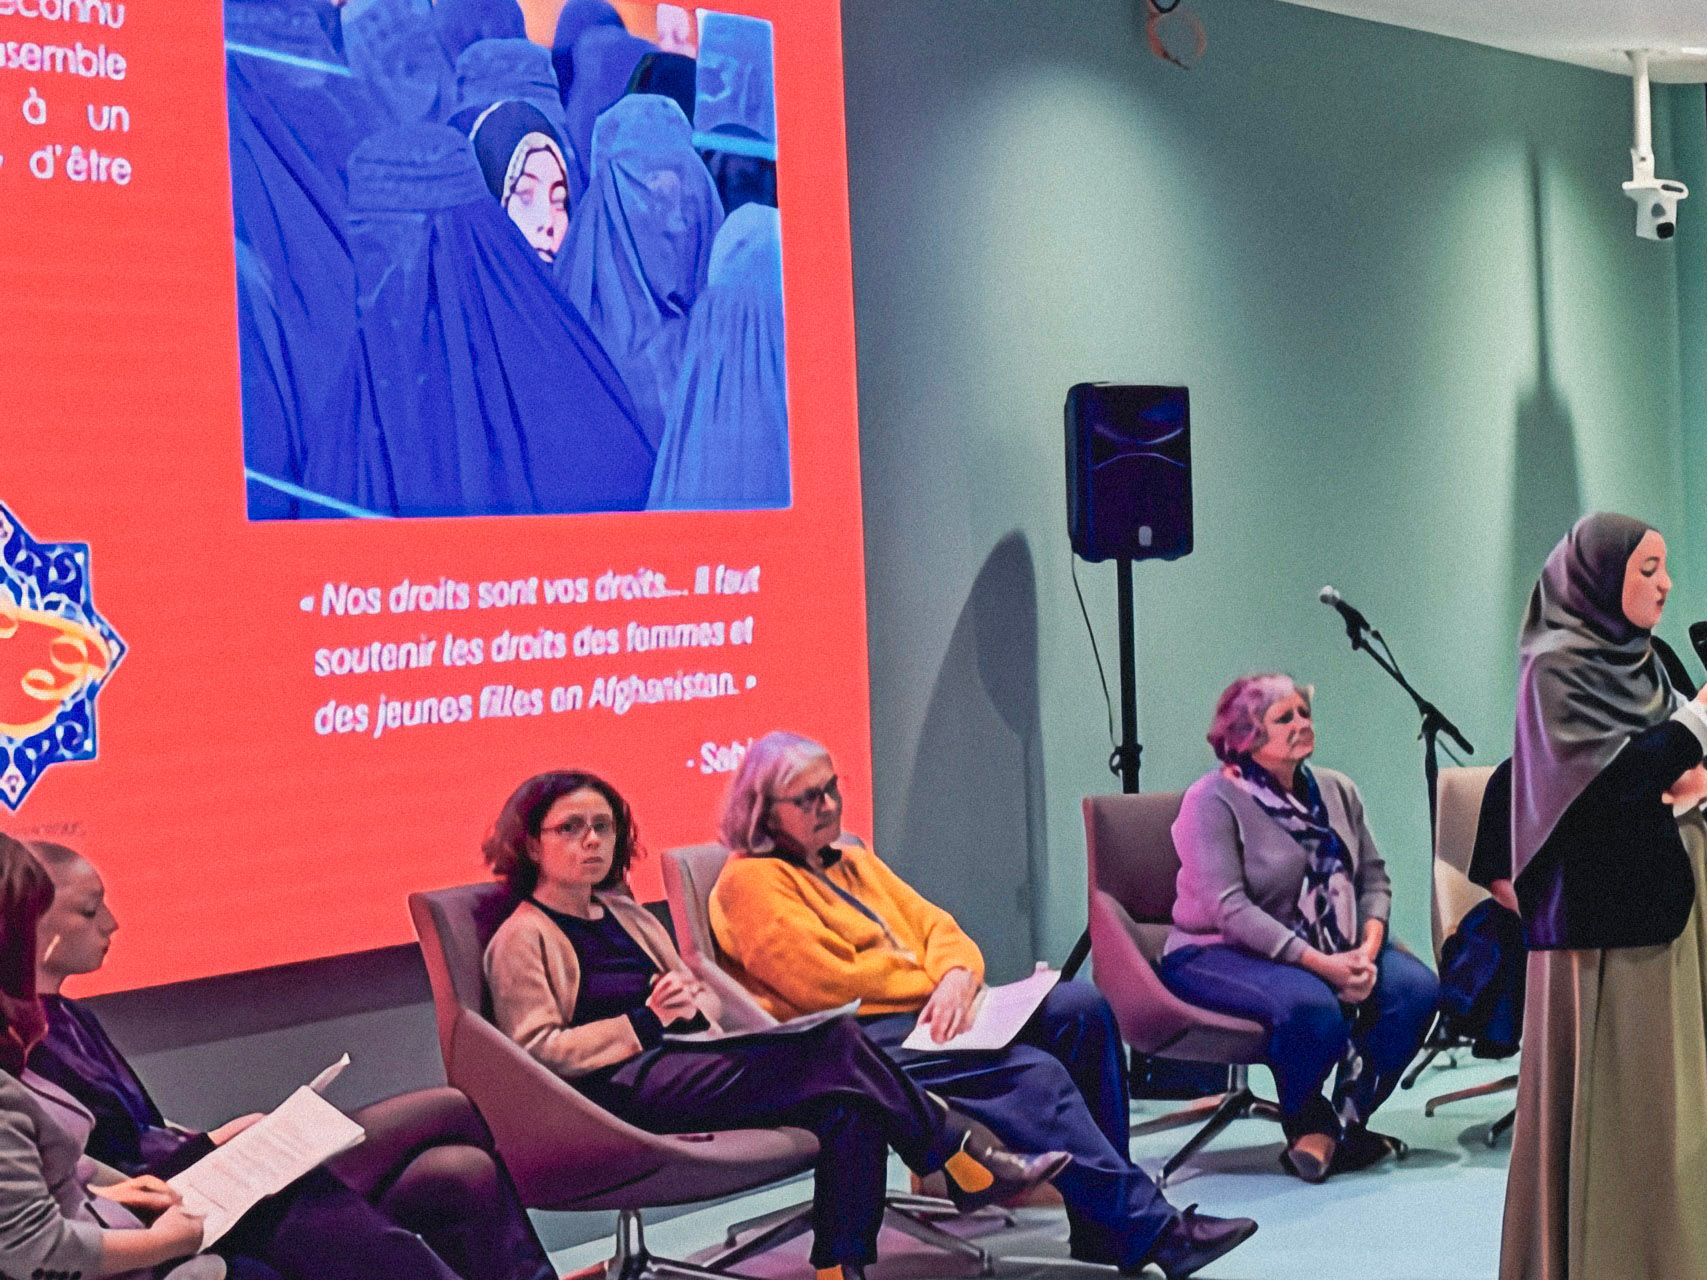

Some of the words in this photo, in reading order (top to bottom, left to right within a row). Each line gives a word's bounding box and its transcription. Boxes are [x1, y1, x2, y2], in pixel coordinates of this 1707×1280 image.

[0, 40, 127, 81] semble
[22, 86, 47, 126] à
[87, 103, 130, 133] un
[29, 144, 132, 186] d'être
[321, 582, 382, 617] Nos
[388, 575, 470, 614] droits
[478, 576, 539, 609] sont
[543, 577, 589, 605] vos
[715, 564, 761, 595] faut
[314, 632, 438, 678] soutenir
[442, 631, 485, 667] les
[490, 628, 568, 662] droits
[573, 625, 620, 658] des
[626, 621, 726, 653] femmes
[730, 616, 755, 646] et
[314, 700, 370, 736] des
[373, 692, 473, 740] jeunes
[479, 684, 544, 720] filles
[550, 684, 584, 714] en
